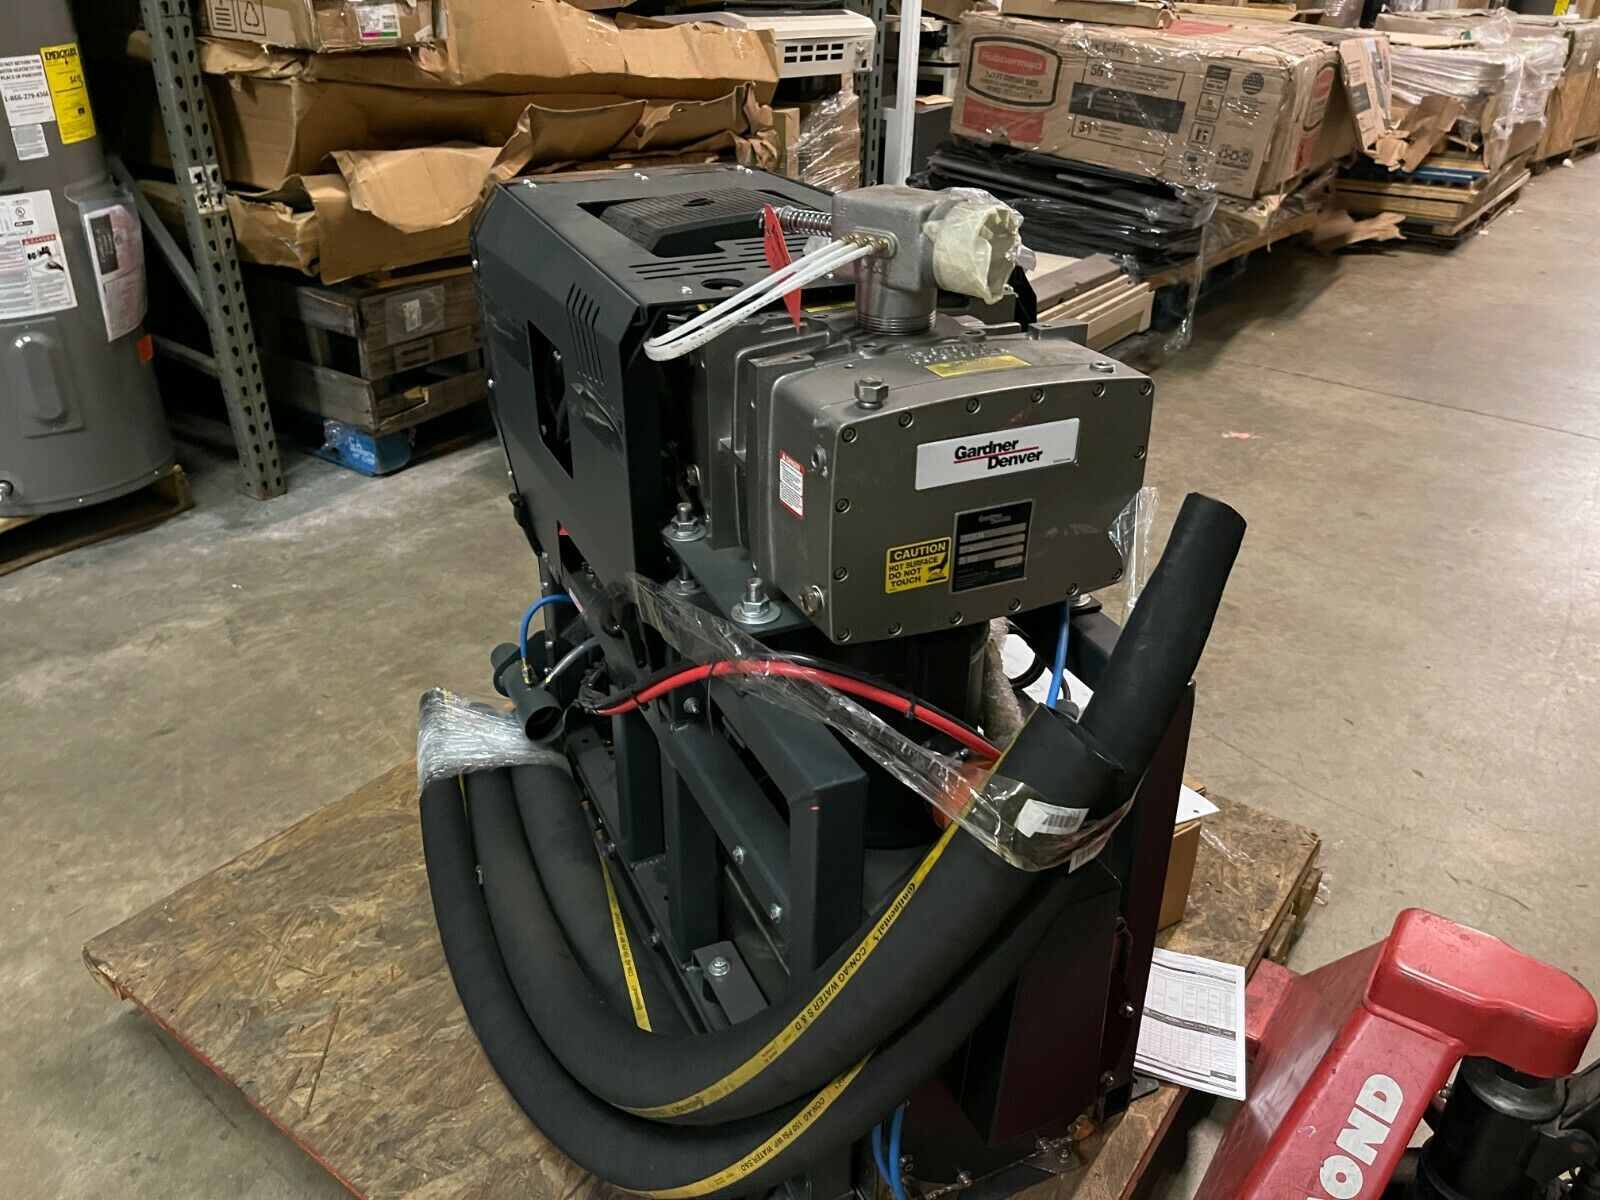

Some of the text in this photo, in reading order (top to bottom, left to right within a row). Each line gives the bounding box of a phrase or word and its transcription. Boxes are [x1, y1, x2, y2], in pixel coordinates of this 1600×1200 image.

[954, 440, 1019, 460] Gardner
[987, 450, 1043, 470] Denver
[894, 541, 947, 560] CAUTION
[889, 556, 939, 573] HOT SURFACE
[889, 567, 921, 580] DO NOT
[890, 575, 921, 588] TOUCH
[878, 882, 916, 936] Continental
[794, 946, 867, 1031] CON-AG WATER S & D
[802, 1097, 825, 1121] CON-AG
[783, 1129, 793, 1140] PSI
[792, 1120, 803, 1132] 150
[774, 1137, 784, 1148] WP
[1306, 1073, 1404, 1200] OND
[752, 1145, 774, 1162] WATER
